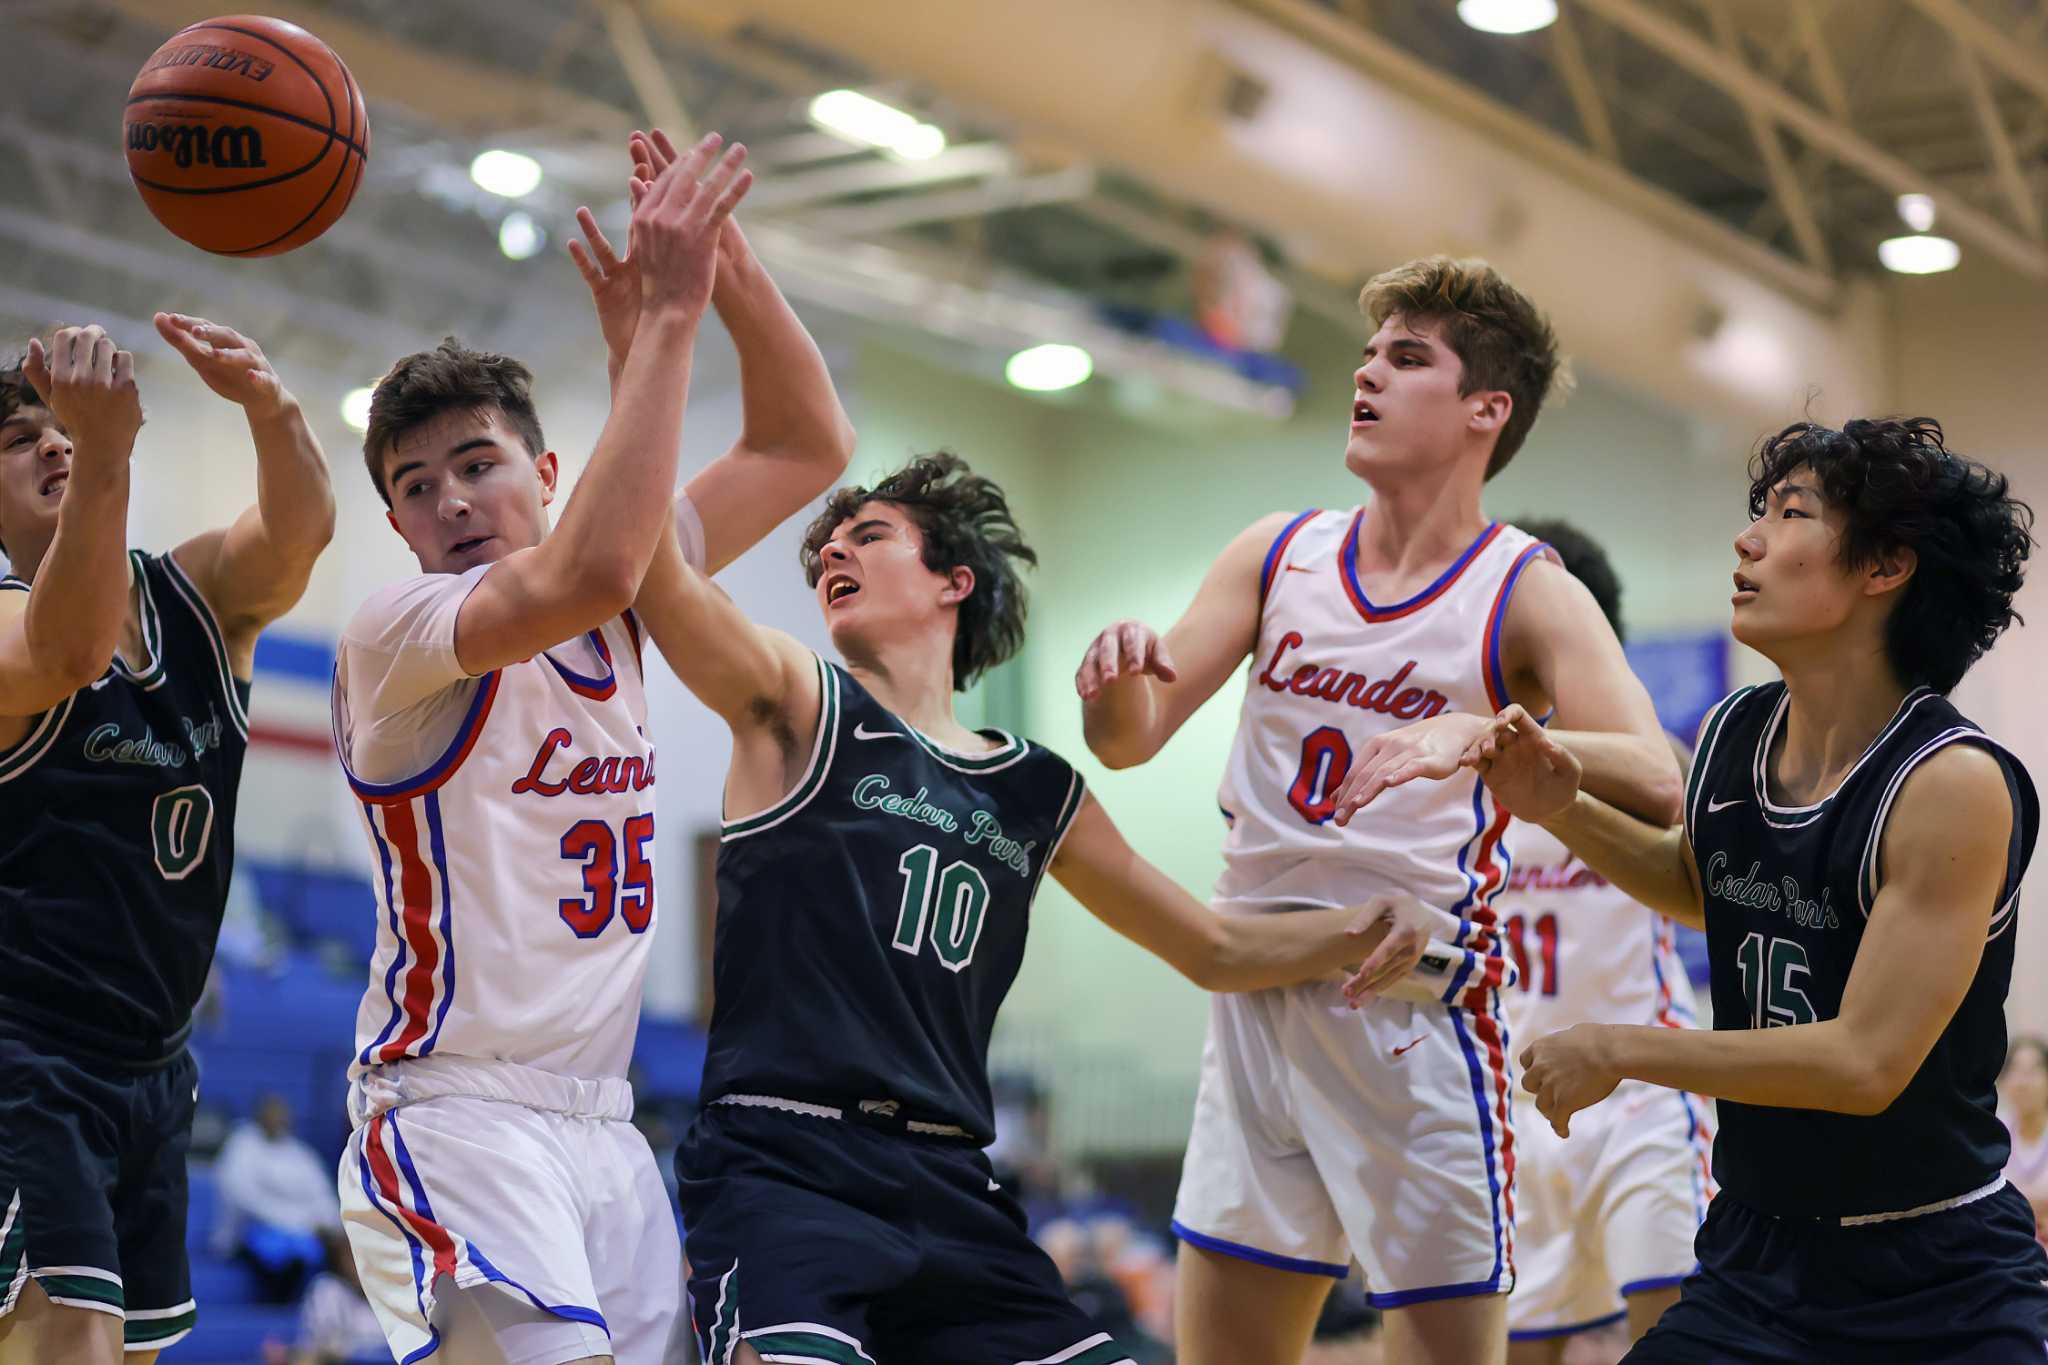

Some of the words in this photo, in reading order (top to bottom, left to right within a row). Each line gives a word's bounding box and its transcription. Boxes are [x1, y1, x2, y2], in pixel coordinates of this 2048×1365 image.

[127, 122, 267, 169] Wilson
[1259, 631, 1449, 720] Leander
[83, 722, 187, 768] Cedar
[1287, 725, 1354, 826] 0
[151, 783, 214, 880] 0
[852, 774, 958, 832] Cedar
[963, 809, 1037, 878] Park
[558, 812, 655, 939] 35
[891, 843, 991, 974] 10
[1706, 850, 1782, 912] Cedar
[1781, 875, 1840, 929] Park
[1503, 913, 1558, 997] 11
[1736, 931, 1818, 1030] 15
